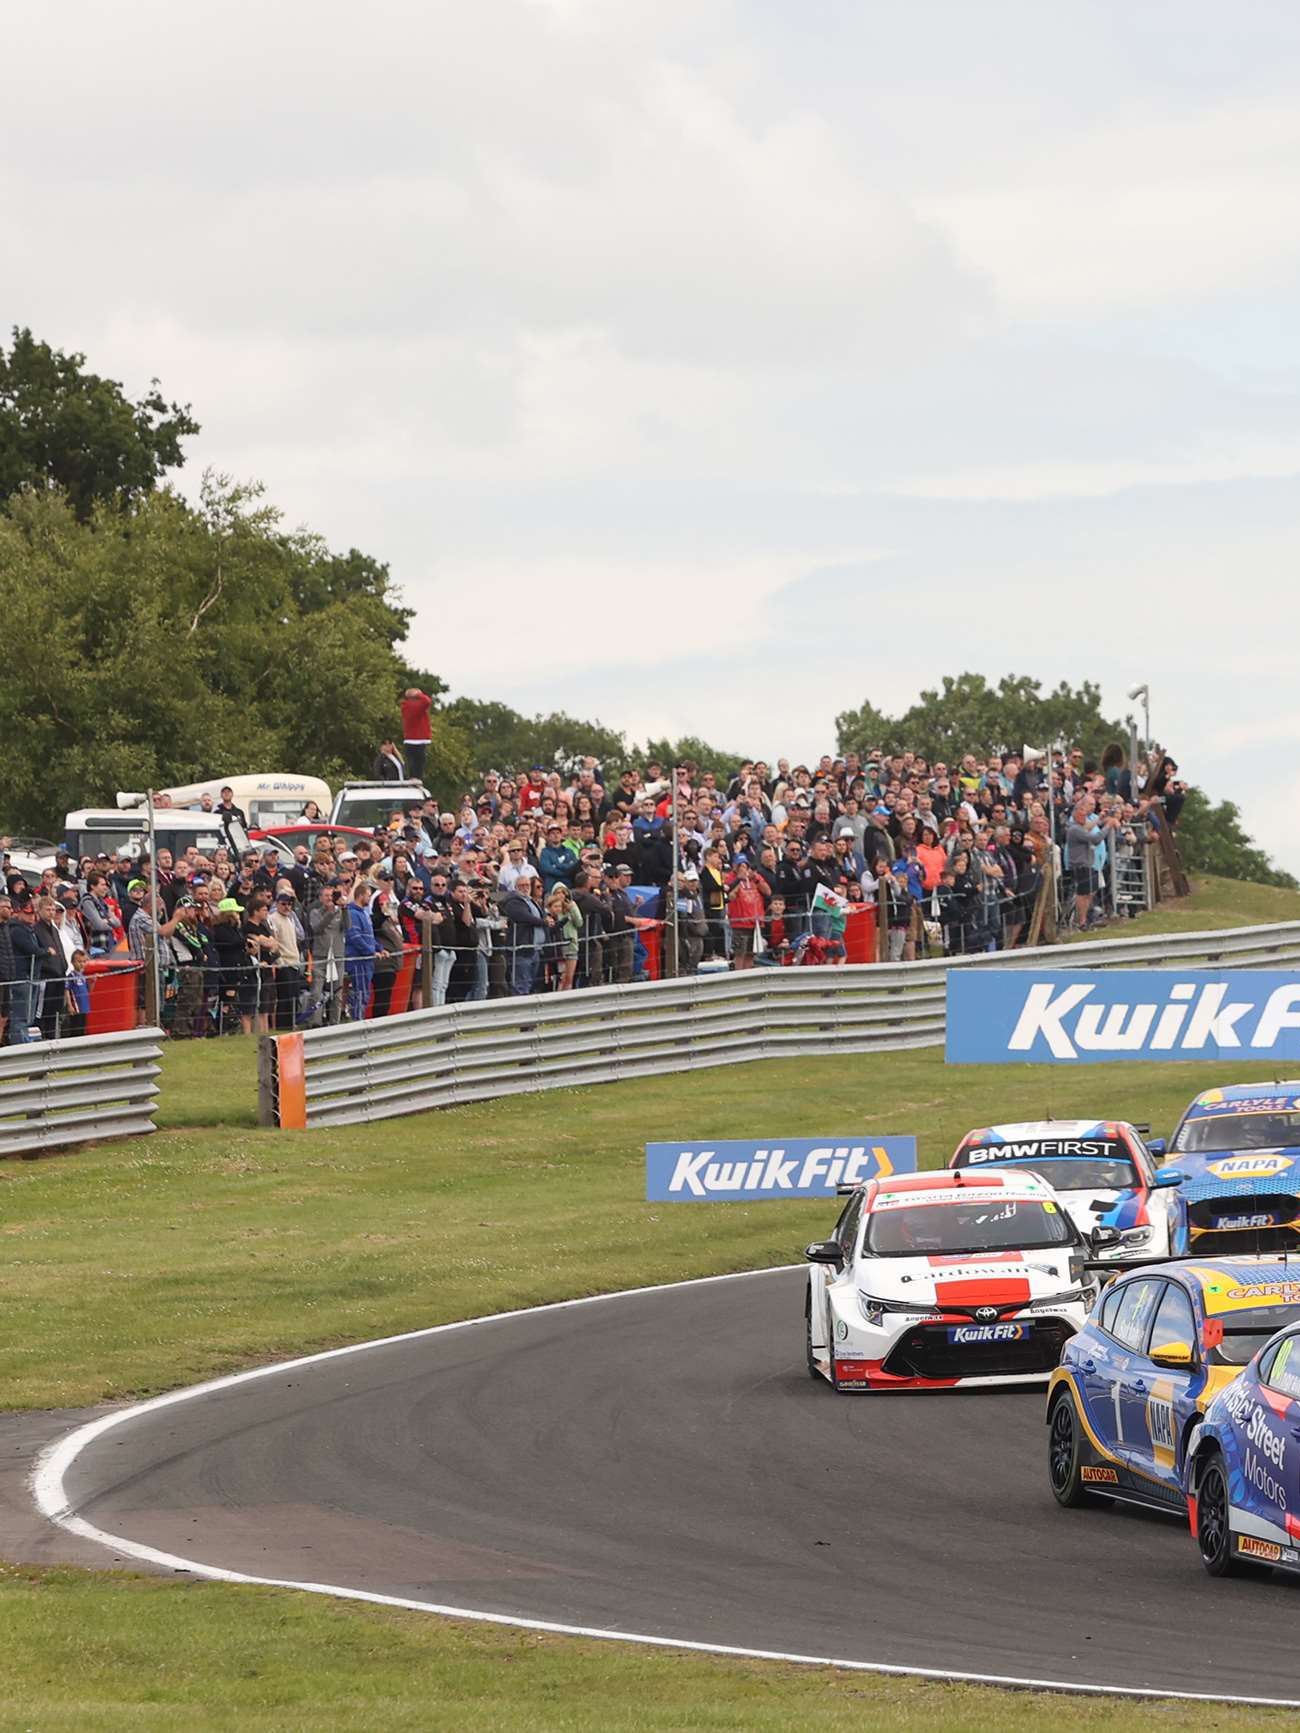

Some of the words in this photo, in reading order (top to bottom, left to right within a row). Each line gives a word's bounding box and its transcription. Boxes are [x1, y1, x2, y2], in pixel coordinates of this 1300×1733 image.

[1203, 1098, 1288, 1110] CARLYLE
[1236, 1104, 1283, 1112] TOOLS
[1221, 1159, 1278, 1172] NAPA
[1149, 1400, 1174, 1447] NAPA
[1247, 1405, 1286, 1471] Street
[1082, 1467, 1117, 1482] AUTOCAR
[1244, 1447, 1287, 1511] Motors
[1242, 1538, 1280, 1559] AUTOCAR
